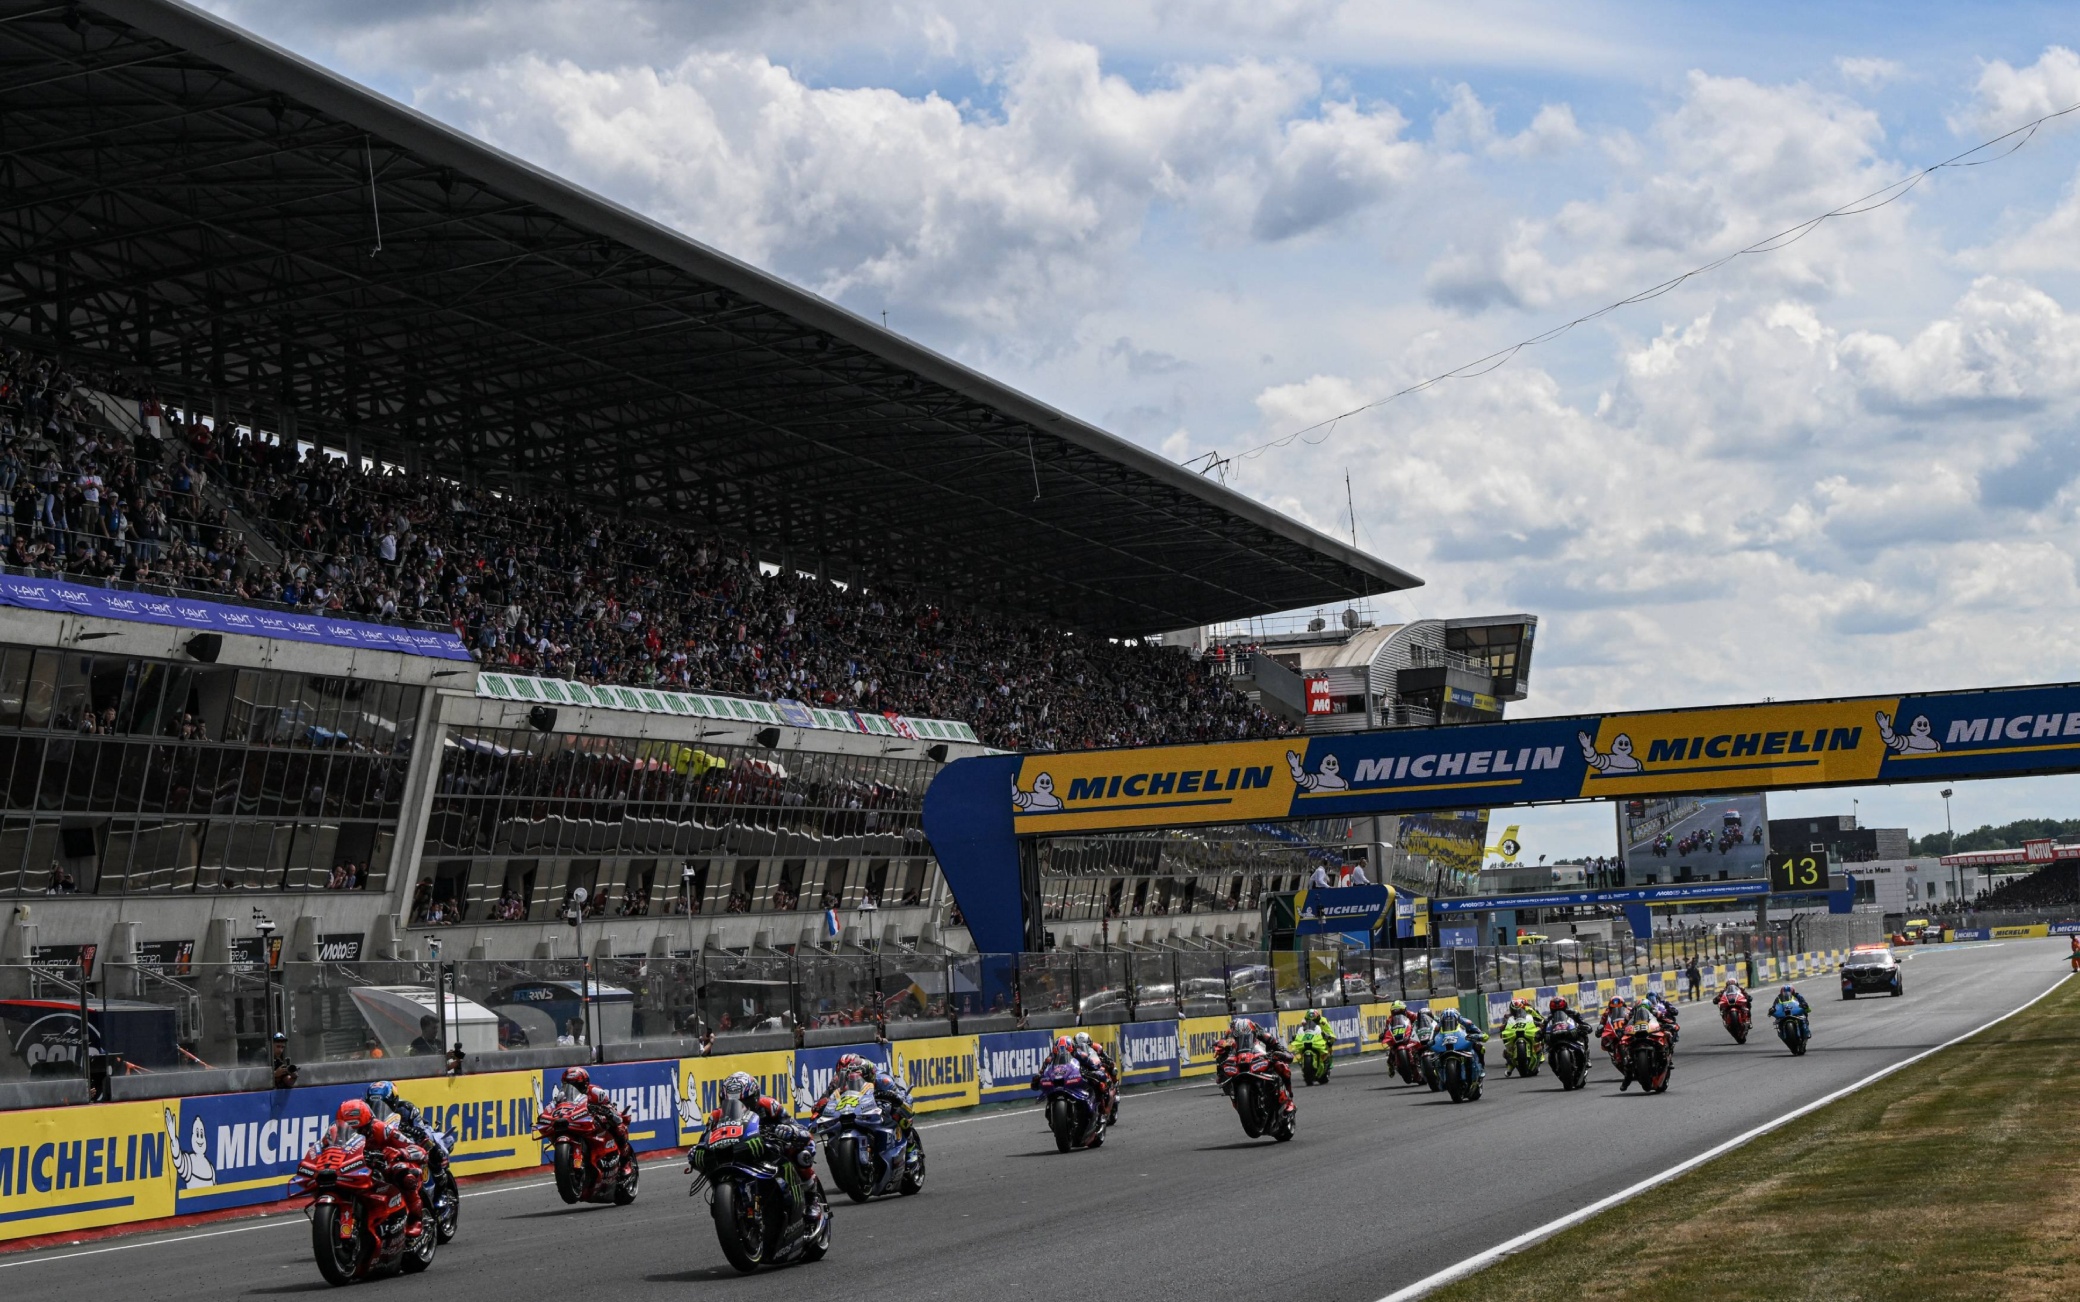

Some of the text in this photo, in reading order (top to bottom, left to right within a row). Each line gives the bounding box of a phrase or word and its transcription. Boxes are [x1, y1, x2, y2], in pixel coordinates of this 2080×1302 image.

[1647, 727, 1863, 762] MICHELIN
[1353, 746, 1565, 782] MICHELIN
[1067, 766, 1273, 800] MICHELIN
[2027, 842, 2053, 860] MOTUL
[1782, 857, 1818, 886] 13
[1324, 904, 1380, 915] MICHELIN
[1996, 928, 2030, 936] MICHELIN
[317, 942, 358, 961] MotoGP
[992, 1047, 1049, 1079] MICHELIN
[1131, 1035, 1176, 1063] MICHELIN
[909, 1054, 974, 1087] MICHELIN
[317, 1148, 347, 1170] 93
[340, 1160, 363, 1173] Lenovo
